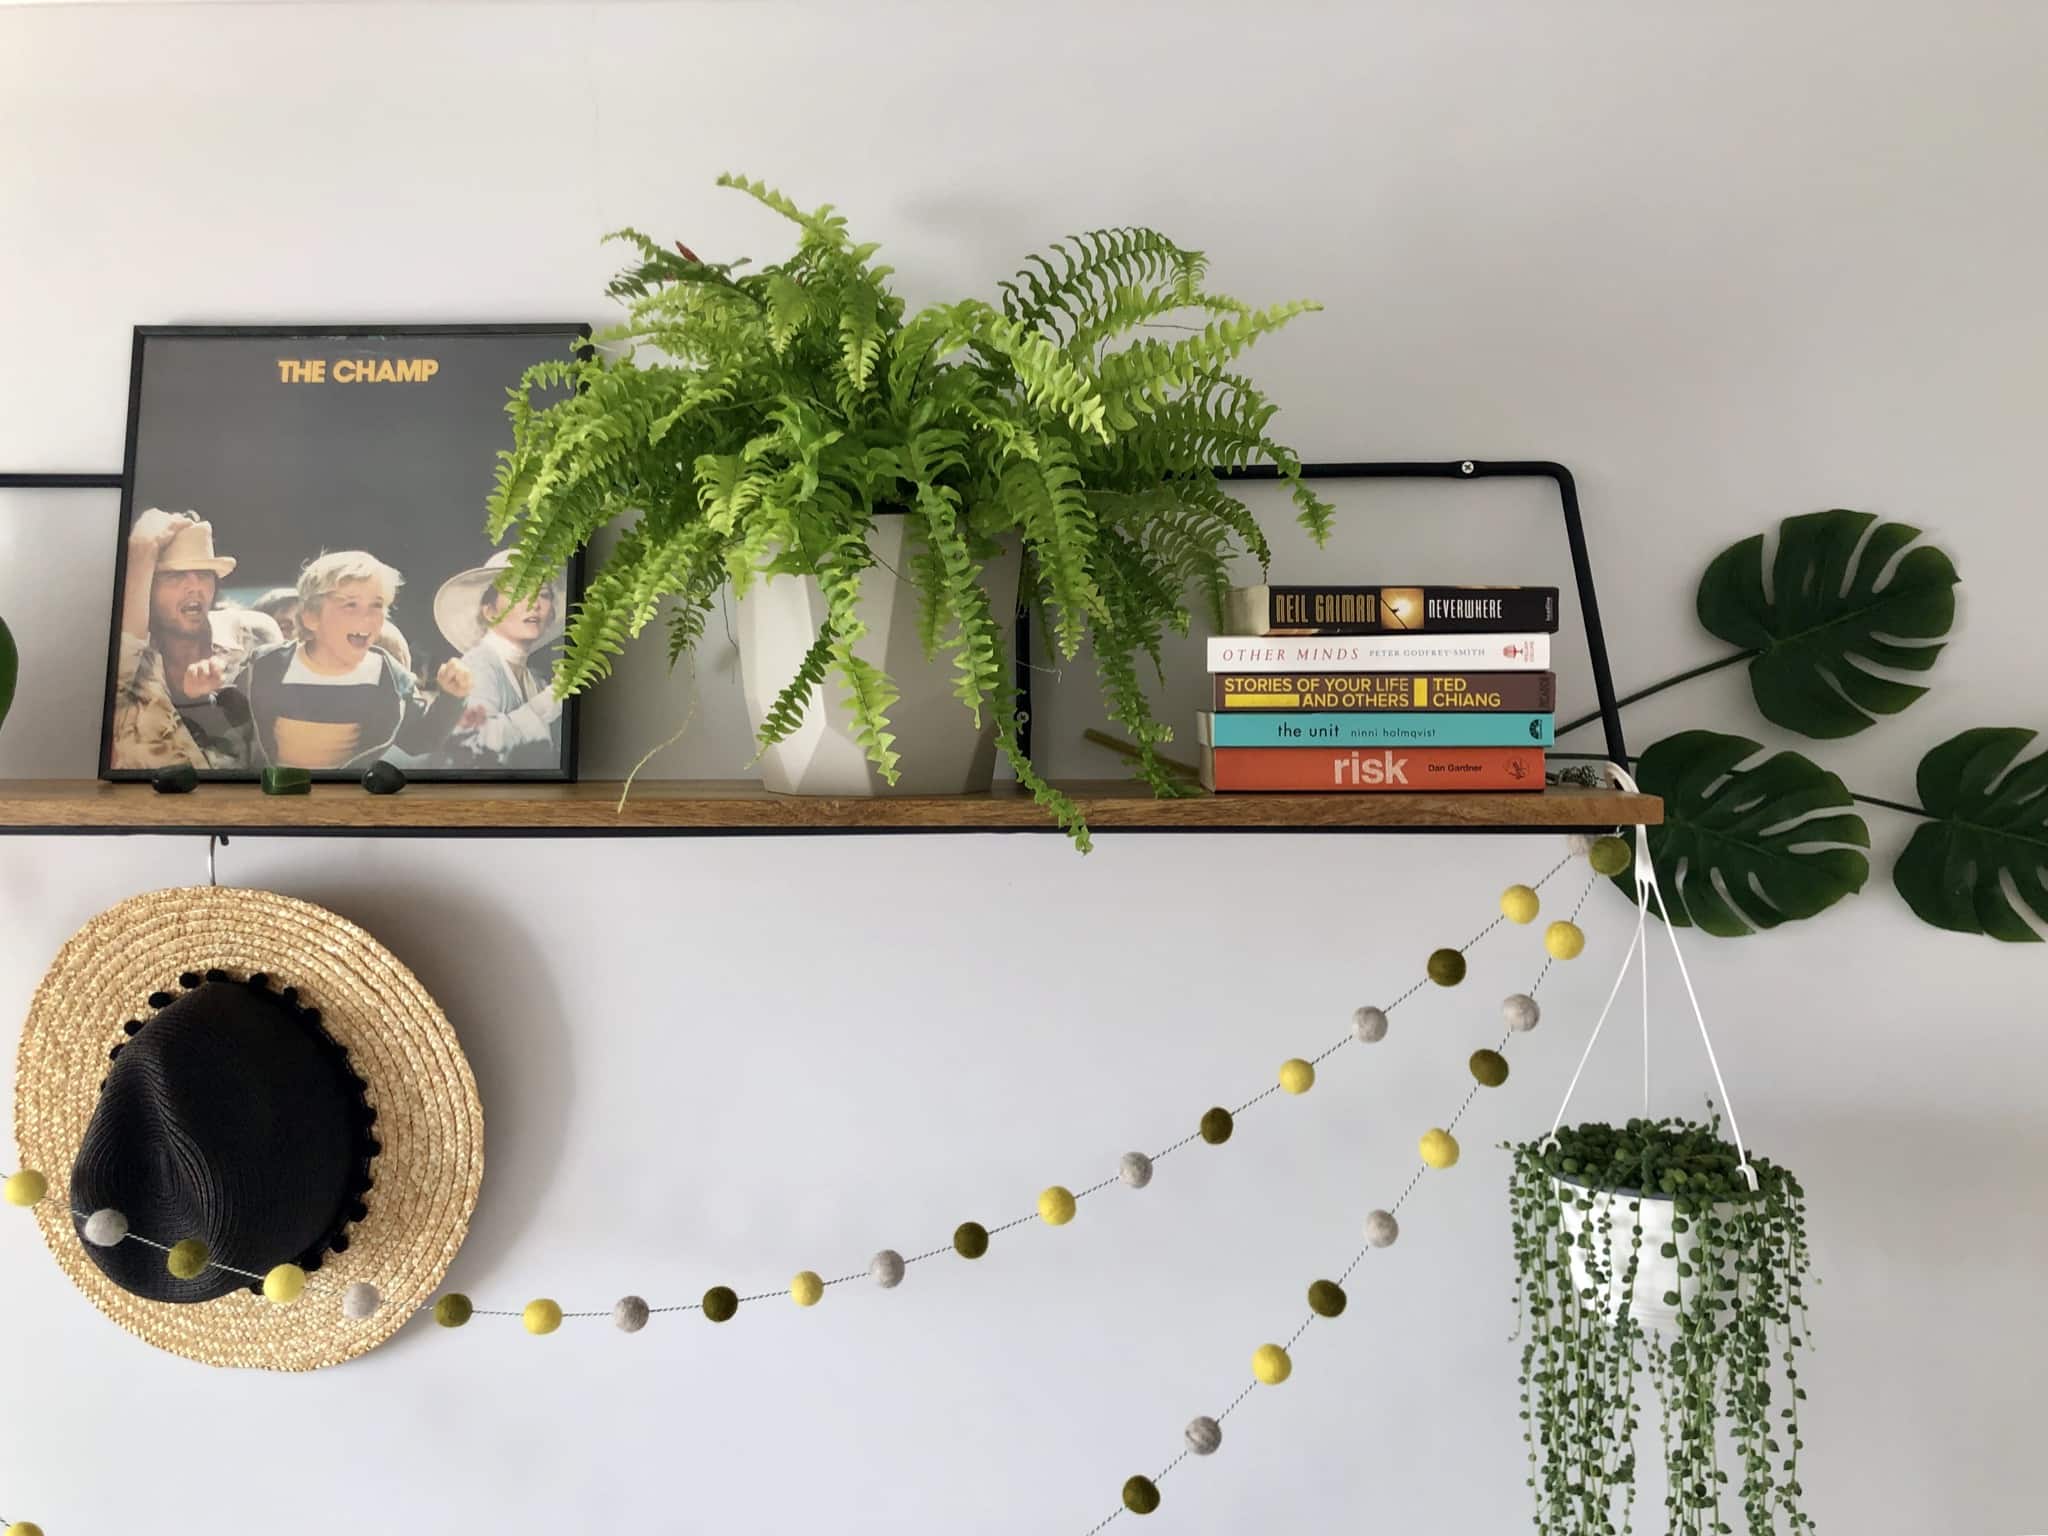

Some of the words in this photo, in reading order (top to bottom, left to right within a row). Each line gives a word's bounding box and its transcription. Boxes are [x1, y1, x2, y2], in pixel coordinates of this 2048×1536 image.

[277, 360, 326, 383] THE
[332, 359, 439, 383] CHAMP
[1275, 594, 1309, 623] NEIL
[1315, 594, 1376, 623] GAIMAN
[1428, 599, 1503, 619] NEVERWHERE
[1222, 648, 1286, 661] OTHER
[1296, 647, 1360, 661] MINDS
[1369, 649, 1400, 657] PETER
[1224, 678, 1292, 692] STORIES
[1296, 678, 1320, 692] OF
[1324, 678, 1371, 692] YOUR
[1376, 678, 1409, 692] LIFE
[1433, 678, 1467, 692] TED
[1302, 693, 1338, 707] AND
[1342, 693, 1409, 708] OTHERS
[1433, 693, 1501, 708] CHIANG
[1278, 722, 1302, 738] the
[1309, 724, 1339, 738] unit
[1351, 727, 1378, 737] ninni
[1383, 727, 1436, 739] holmqvist
[1333, 750, 1409, 785] risk
[1428, 764, 1445, 772] Dan
[1447, 763, 1483, 773] Gardner
